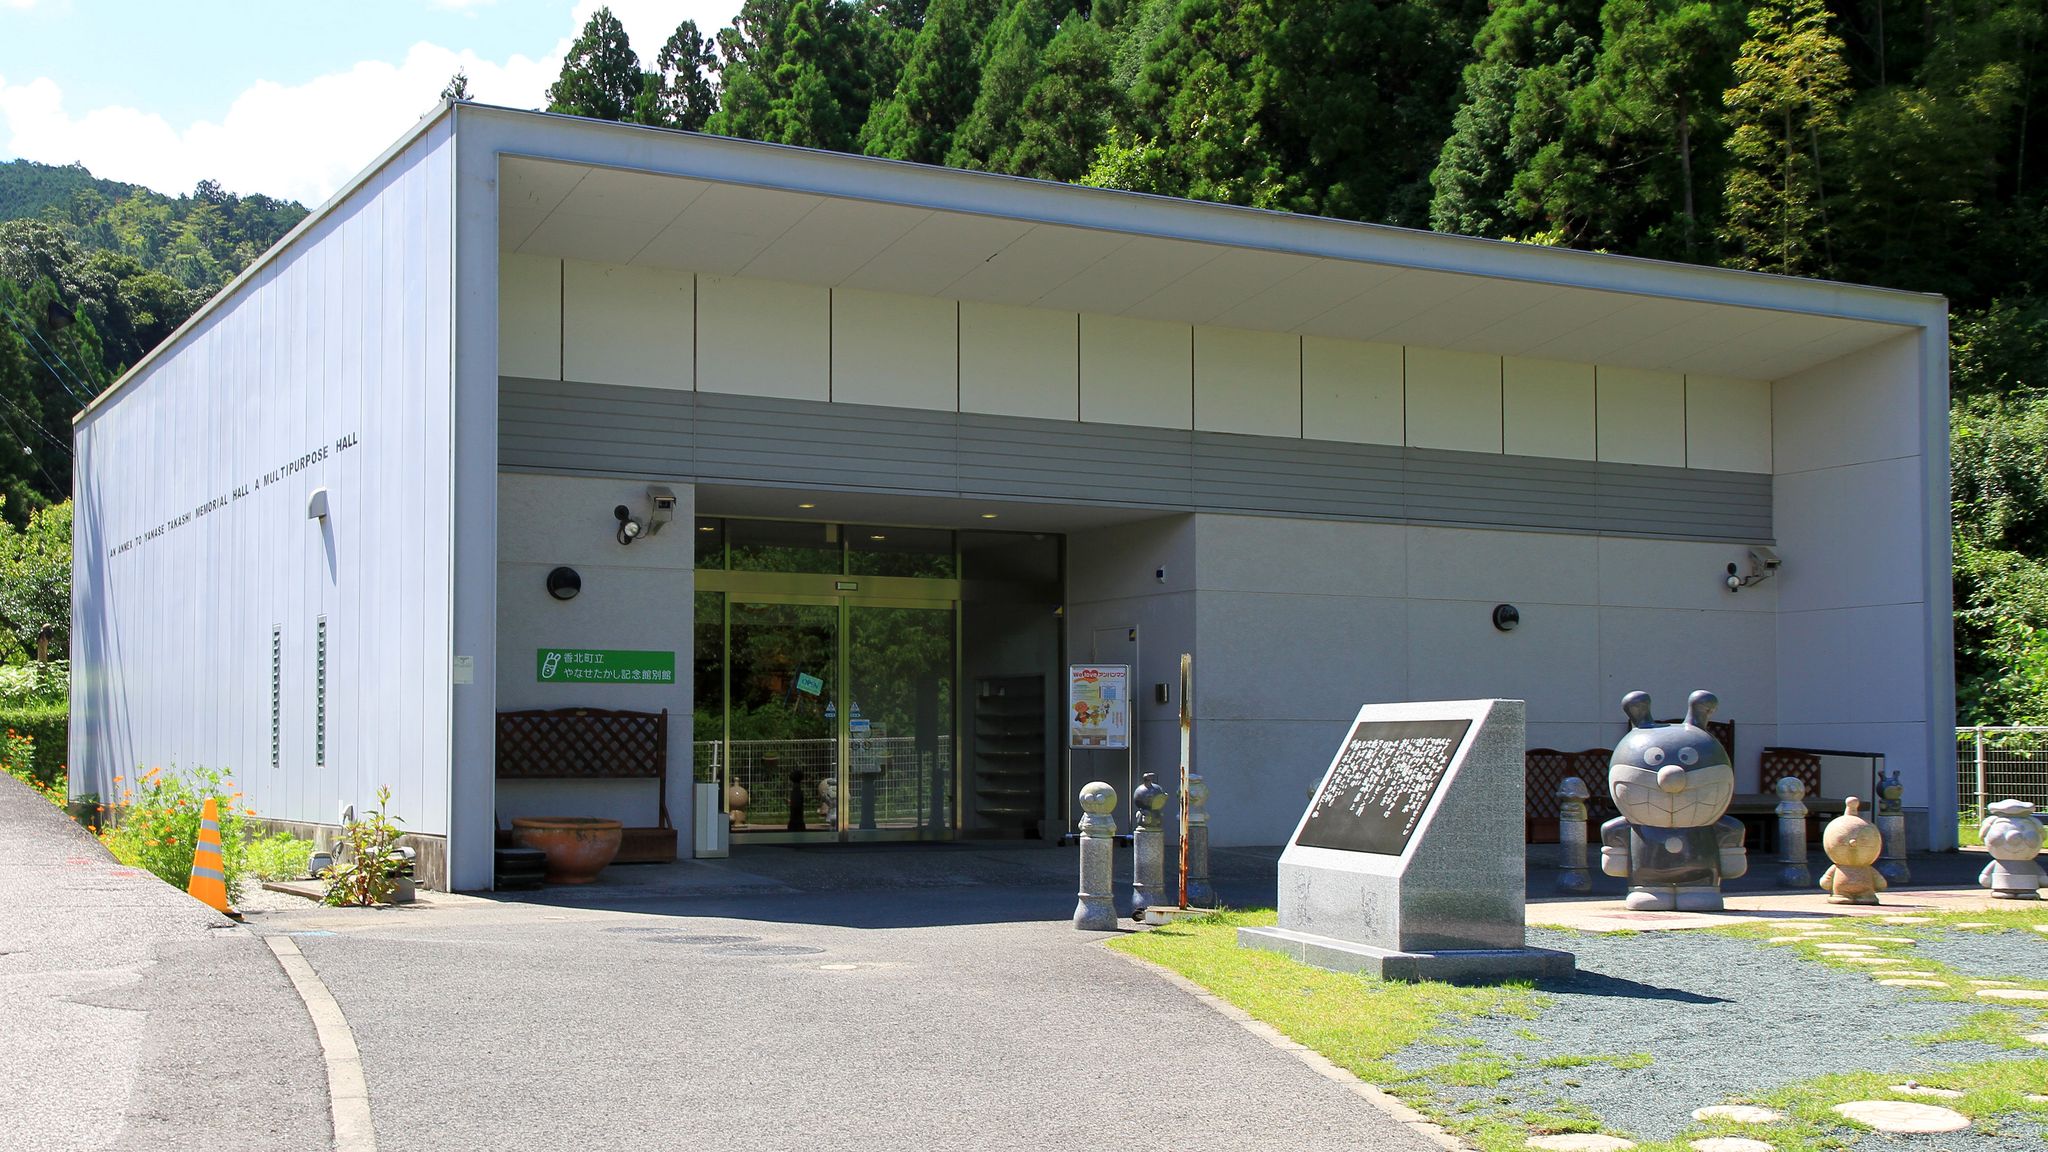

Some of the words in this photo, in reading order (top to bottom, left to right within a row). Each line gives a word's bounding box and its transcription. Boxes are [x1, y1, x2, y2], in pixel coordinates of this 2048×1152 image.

[110, 547, 117, 558] AN
[118, 540, 133, 554] ANNEX
[135, 535, 143, 546] TO
[144, 524, 165, 542] YANASE
[167, 511, 192, 531] TAKASHI
[195, 493, 228, 518] MEMORIAL
[232, 483, 249, 501] HALL
[254, 478, 260, 491] A
[263, 445, 329, 487] MULTIPURPOSE
[336, 431, 358, 453] HALL
[563, 652, 605, 664] 香北町立
[563, 667, 672, 681] やなせたかし記念館別館
[802, 678, 818, 689] OPEN
